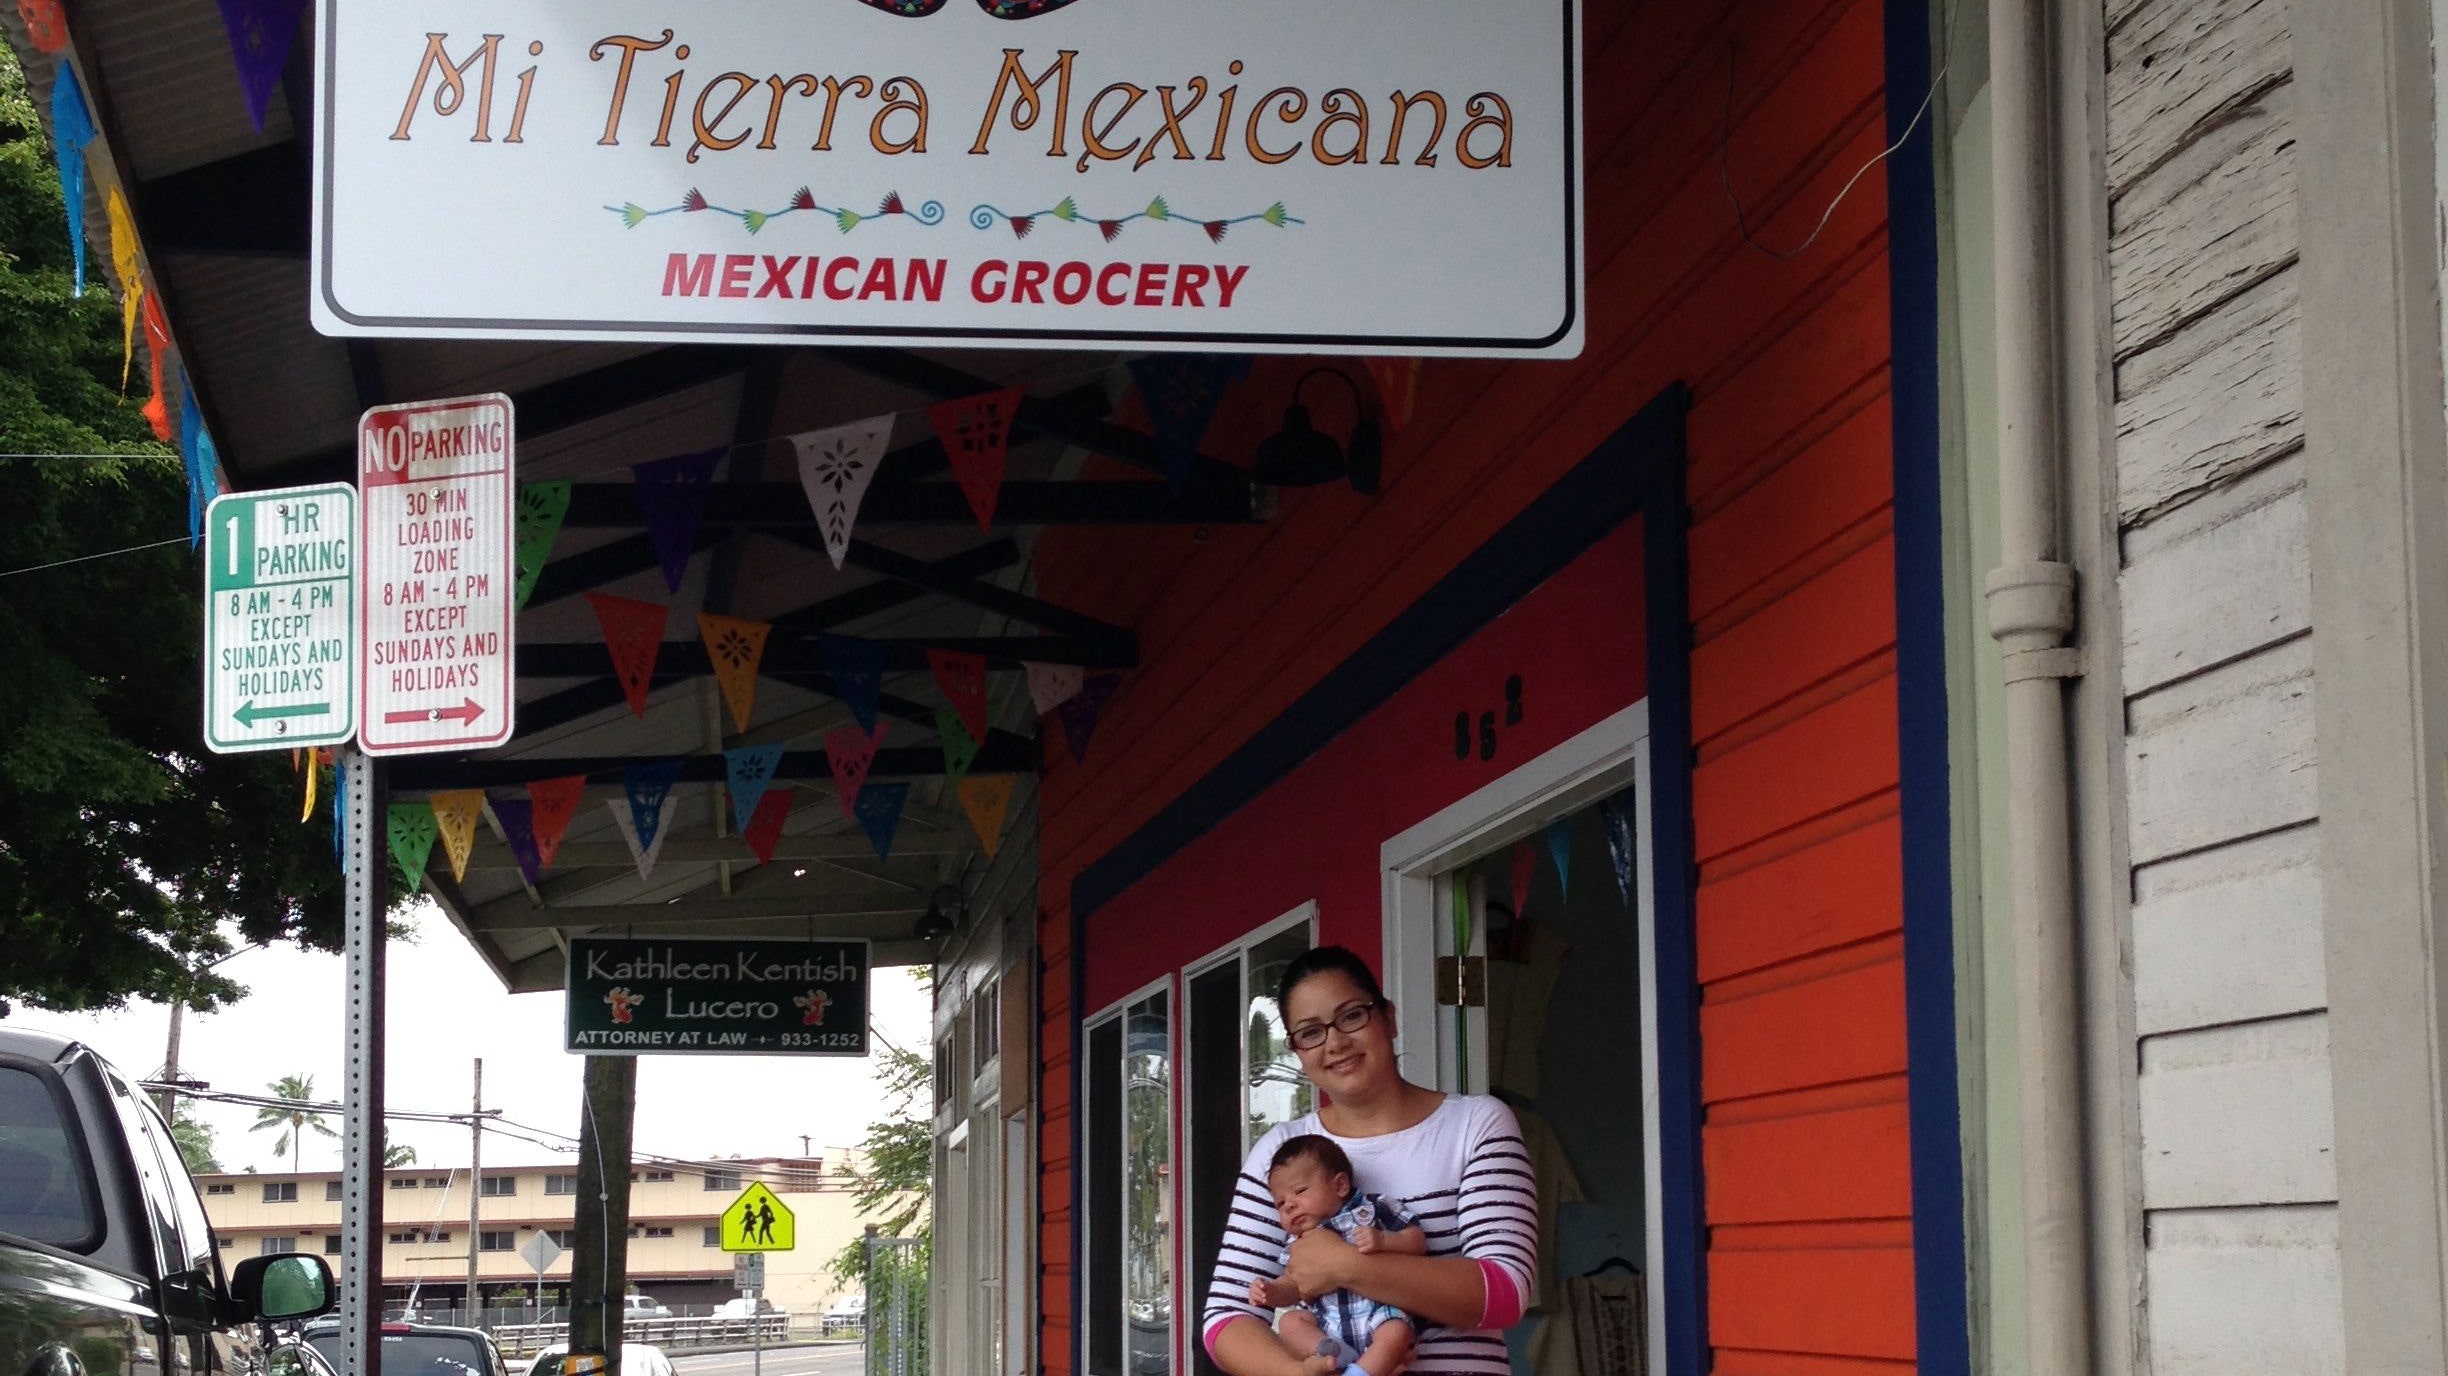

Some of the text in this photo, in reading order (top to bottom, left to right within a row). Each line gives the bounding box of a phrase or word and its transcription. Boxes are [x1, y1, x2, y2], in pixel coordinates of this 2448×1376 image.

[389, 29, 1513, 173] Mi Tierra Mexicana
[661, 253, 1250, 308] MEXICAN GROCERY
[364, 422, 502, 474] NO PARKING
[405, 488, 467, 517] 30 MIN
[226, 502, 320, 576] 1 HR
[399, 517, 474, 546] LOADING
[257, 539, 346, 577] PARKING
[413, 548, 459, 574] ZONE
[230, 595, 240, 616] 8
[247, 591, 271, 615] AM
[291, 588, 301, 610] 4
[310, 585, 333, 608] PM
[383, 583, 393, 606] 8
[400, 579, 425, 604] AM
[446, 578, 457, 599] 4
[466, 574, 489, 598] PM
[251, 615, 311, 641] EXCEPT
[405, 605, 467, 633] EXCEPT
[222, 639, 343, 671] SUNDAYS AND
[374, 632, 498, 665] SUNDAYS AND
[239, 668, 323, 696] HOLIDAYS
[392, 663, 479, 693] HOLIDAYS
[586, 947, 857, 982] Kathleen Kentish
[664, 987, 779, 1019] Lucero
[575, 1030, 860, 1047] ATTORNEY AT LAW 933-1252
